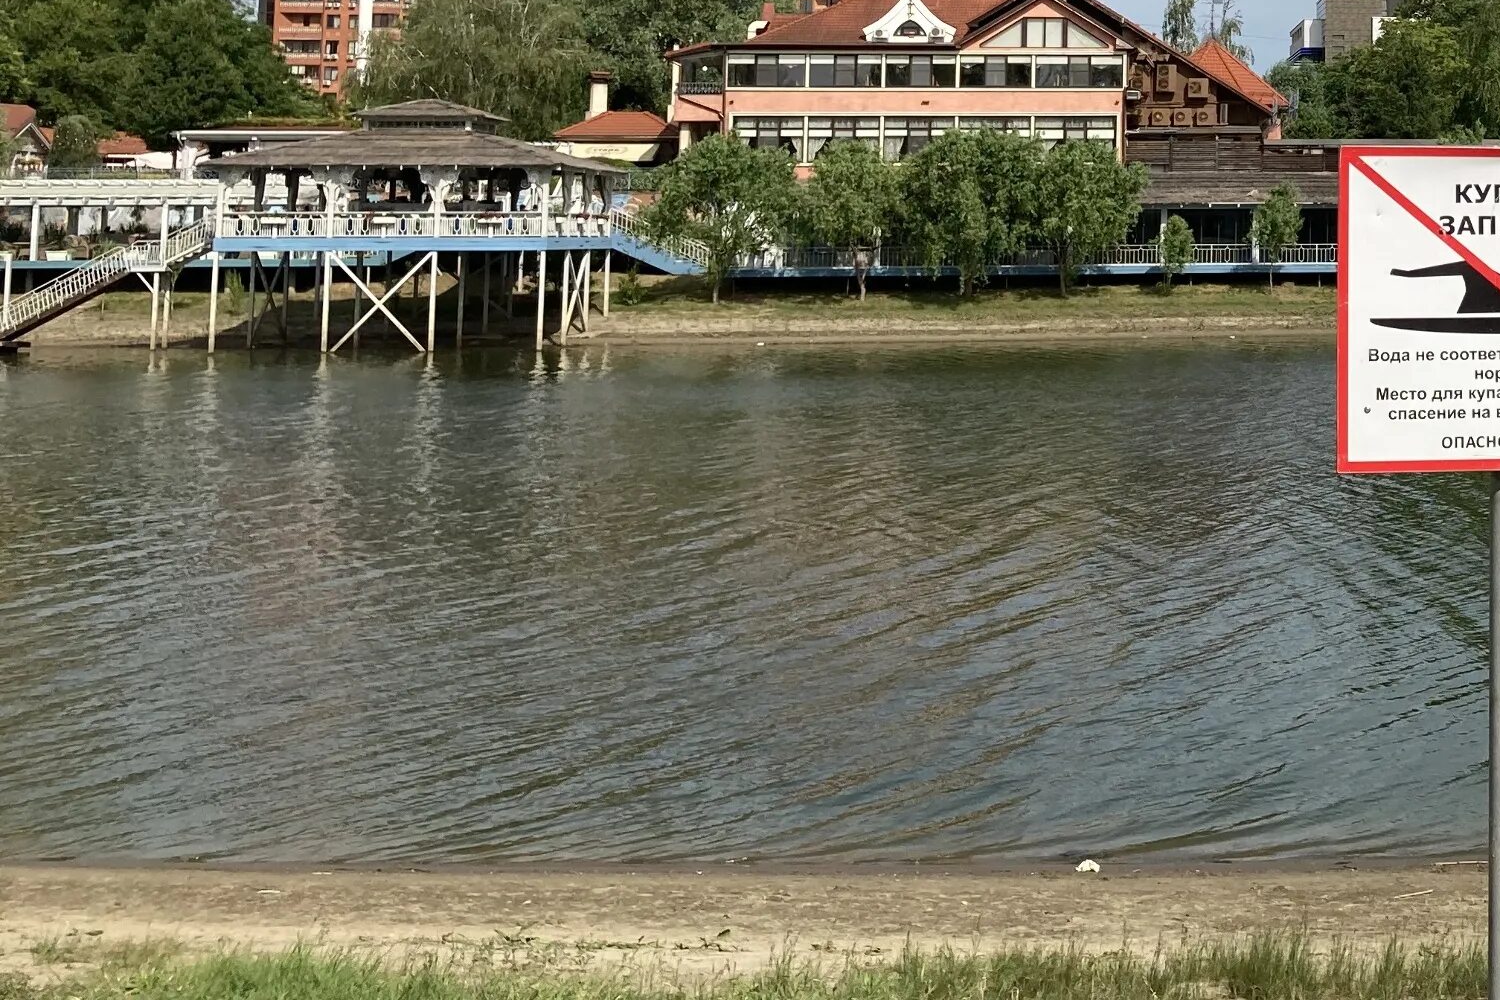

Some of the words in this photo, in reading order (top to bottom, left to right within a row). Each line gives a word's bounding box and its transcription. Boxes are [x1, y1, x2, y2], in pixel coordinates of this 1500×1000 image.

[1368, 348, 1410, 364] Вода
[1416, 350, 1435, 361] не
[1376, 387, 1427, 401] Место
[1431, 389, 1463, 402] для
[1388, 408, 1467, 421] спасение
[1472, 408, 1491, 419] на
